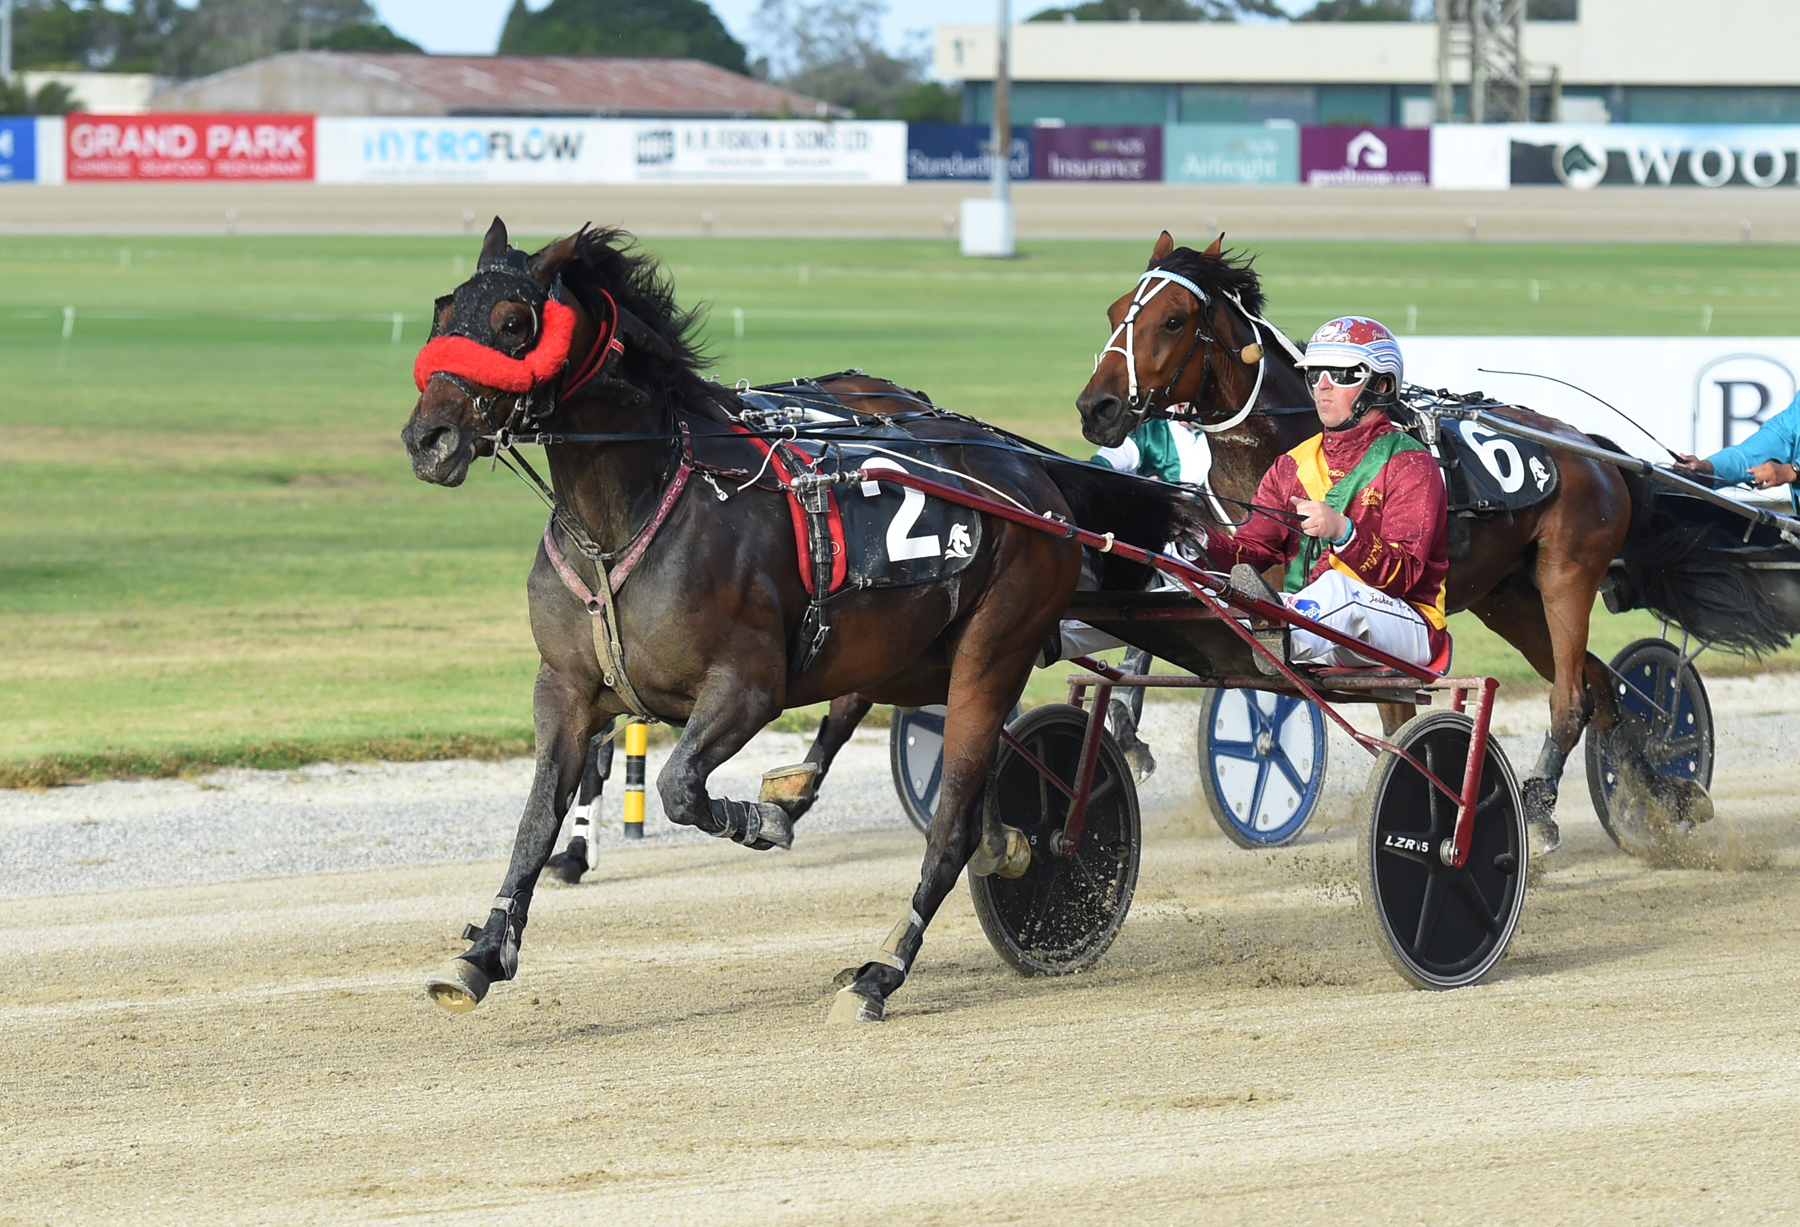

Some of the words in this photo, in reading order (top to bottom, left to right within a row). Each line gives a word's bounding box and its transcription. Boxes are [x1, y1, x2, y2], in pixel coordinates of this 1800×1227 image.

[70, 123, 197, 158] GRAND
[206, 124, 307, 158] PARK
[1624, 141, 1800, 188] WOO
[1048, 152, 1146, 179] Insurance
[1459, 420, 1525, 493] 6
[649, 478, 683, 529] DICKIE
[860, 457, 942, 563] 2
